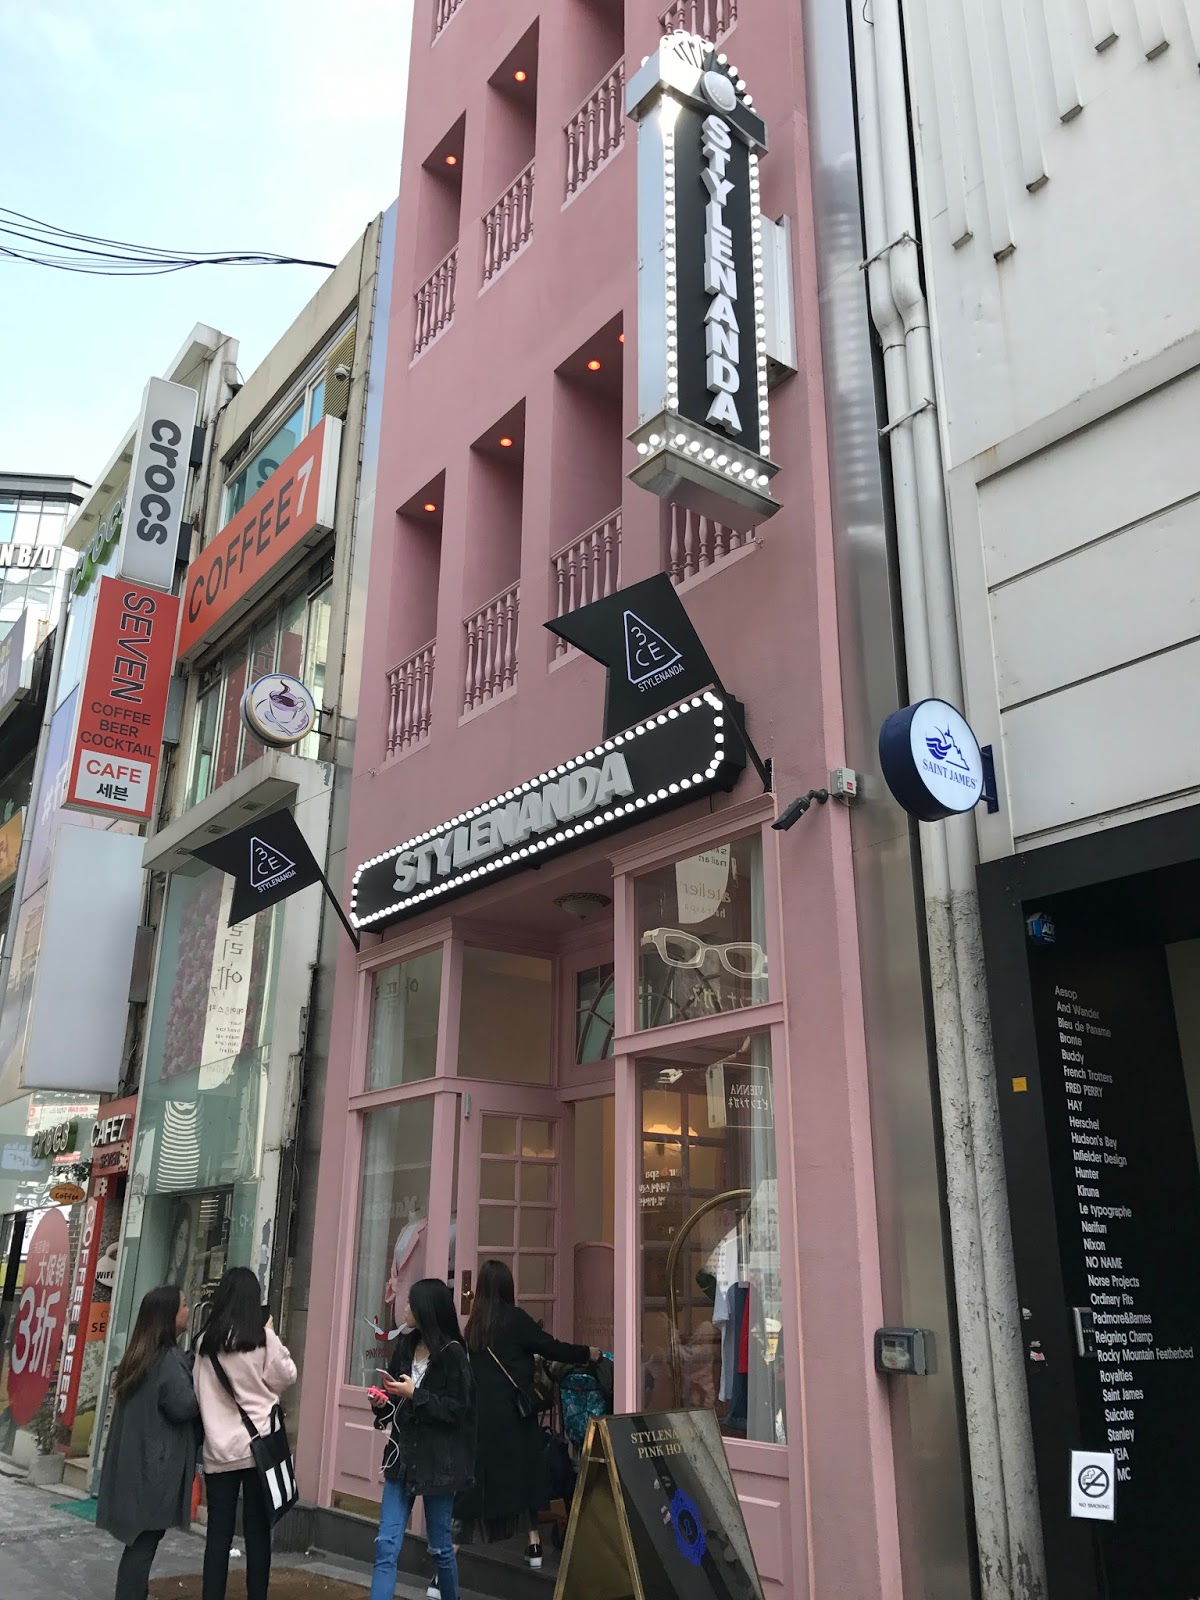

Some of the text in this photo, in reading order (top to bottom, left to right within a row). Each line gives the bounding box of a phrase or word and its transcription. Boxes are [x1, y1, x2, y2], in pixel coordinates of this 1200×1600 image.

[701, 114, 743, 437] STYLENANDA
[136, 419, 182, 546] crocs
[17, 545, 56, 569] B/D
[110, 590, 156, 704] SEVEN
[637, 663, 686, 692] STYLENANDA
[91, 701, 152, 726] COFFEE
[99, 719, 139, 738] BEER
[80, 731, 156, 758] COCKTAIL
[86, 760, 142, 784] CAFE
[922, 758, 977, 790] SAINT JAMES
[96, 783, 129, 802] 세븐
[392, 750, 634, 893] STYLENANDA
[257, 869, 297, 893] STYLENANDA
[1055, 985, 1078, 1001] Aesop
[1057, 1001, 1100, 1020] And Wander
[1057, 1016, 1112, 1038] Bleu de Paname
[1059, 1032, 1083, 1046] Bronte
[1061, 1048, 1084, 1065] Buddy
[1063, 1065, 1113, 1084] French Trotters
[1065, 1081, 1103, 1098] FRED PERRY
[1067, 1099, 1083, 1112] HAY
[1069, 1115, 1100, 1130] Herschel
[1071, 1131, 1118, 1150] Hudson's Bay
[1103, 1152, 1128, 1168] Design
[1075, 1166, 1100, 1180] Hunter
[1077, 1184, 1100, 1198] Kiruna
[1079, 1202, 1132, 1219] Le typographe
[1083, 1237, 1106, 1251] Nixon
[72, 1205, 96, 1322] COFFEE
[1085, 1255, 1123, 1269] NO NAME
[1087, 1274, 1140, 1290] Norse Projects
[1090, 1292, 1134, 1308] Ordinary Fits
[1092, 1311, 1152, 1325] Padmore&Barnes
[1095, 1330, 1154, 1346] Reigning Champ
[1097, 1346, 1194, 1364] Rocky Mountain Featherbed
[58, 1334, 77, 1414] BEER
[1100, 1368, 1134, 1385] Royalties
[1102, 1387, 1144, 1402] Saint James
[1104, 1407, 1135, 1422] Suicoke
[1107, 1426, 1135, 1442] Stanley
[637, 1445, 664, 1459] PINK
